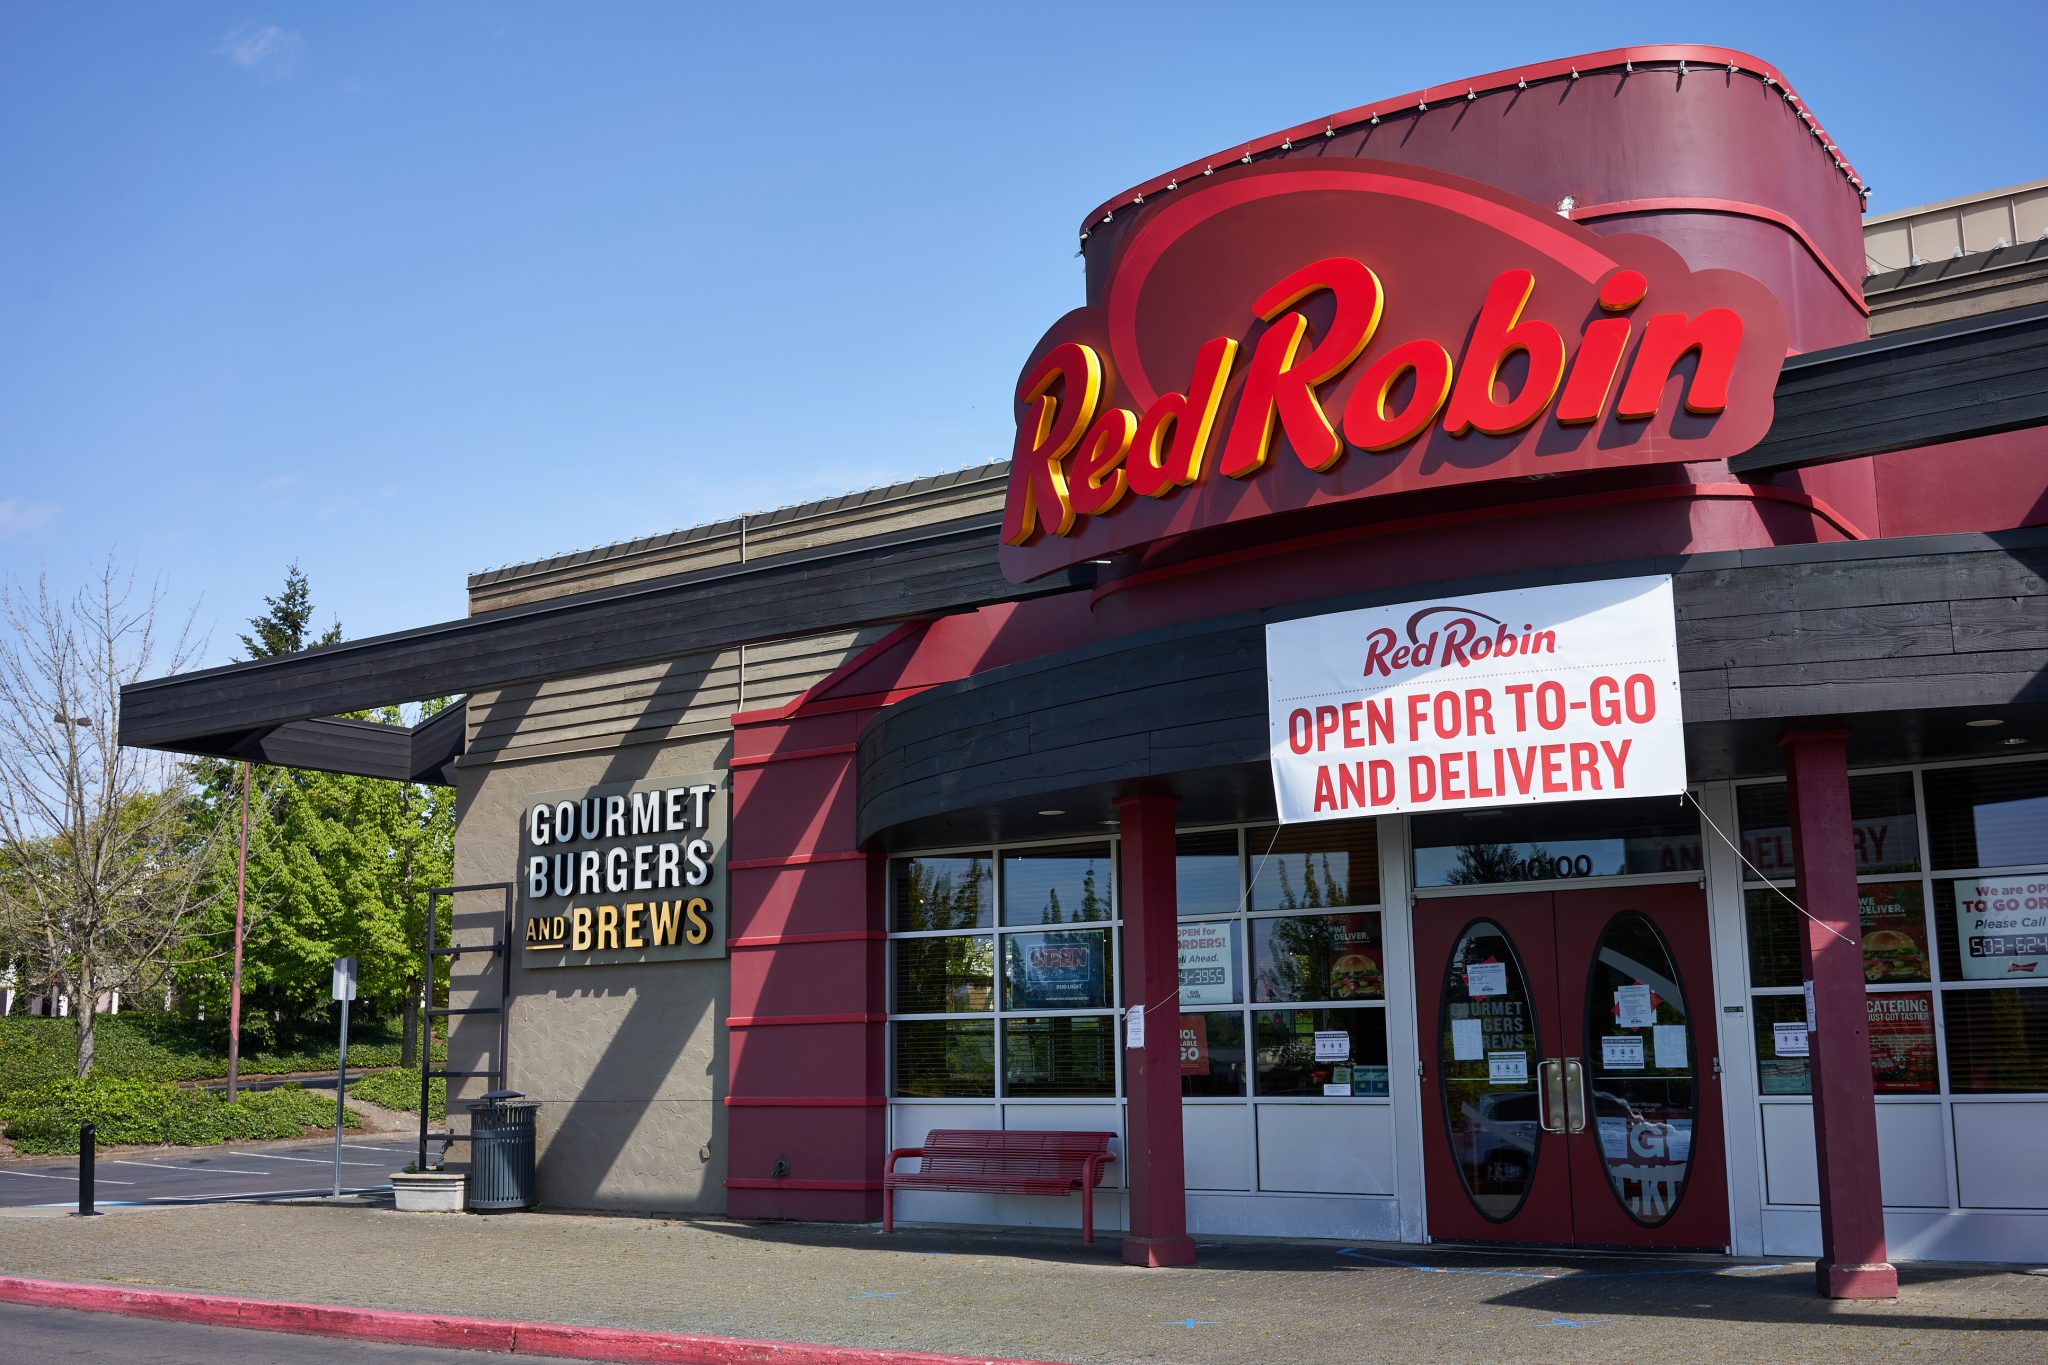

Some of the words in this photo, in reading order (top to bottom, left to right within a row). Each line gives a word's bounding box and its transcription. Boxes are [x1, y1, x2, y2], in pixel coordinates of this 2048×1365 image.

[1003, 336, 1239, 548] Red
[1219, 256, 1745, 474] Robin
[1362, 627, 1438, 677] Red
[1440, 617, 1557, 668] Robin
[1288, 697, 1395, 756] OPEN
[1408, 688, 1496, 742] FOR
[1505, 673, 1657, 733] TO-GO
[1313, 758, 1396, 812] AND
[1408, 739, 1633, 804] DELIVERY
[530, 784, 716, 846] GOURMET
[529, 838, 712, 899] BURGERS
[1516, 854, 1593, 880] 10100
[1858, 896, 1875, 906] WE
[1975, 886, 1998, 897] We
[2001, 886, 2023, 896] are
[2026, 883, 2048, 894] OP
[1962, 900, 1988, 913] TO
[1992, 898, 2020, 912] GO
[525, 915, 567, 941] AND
[572, 897, 710, 951] BREWS
[1202, 927, 1216, 935] for
[1333, 925, 1347, 933] WE
[1974, 919, 2017, 930] Please
[2021, 916, 2047, 928] Call
[1028, 946, 1089, 969] OPEN
[1866, 999, 1929, 1013] CATERING
[1868, 1013, 1884, 1022] JUST
[1885, 1012, 1899, 1021] GOT
[1901, 1011, 1929, 1021] TASTIER
